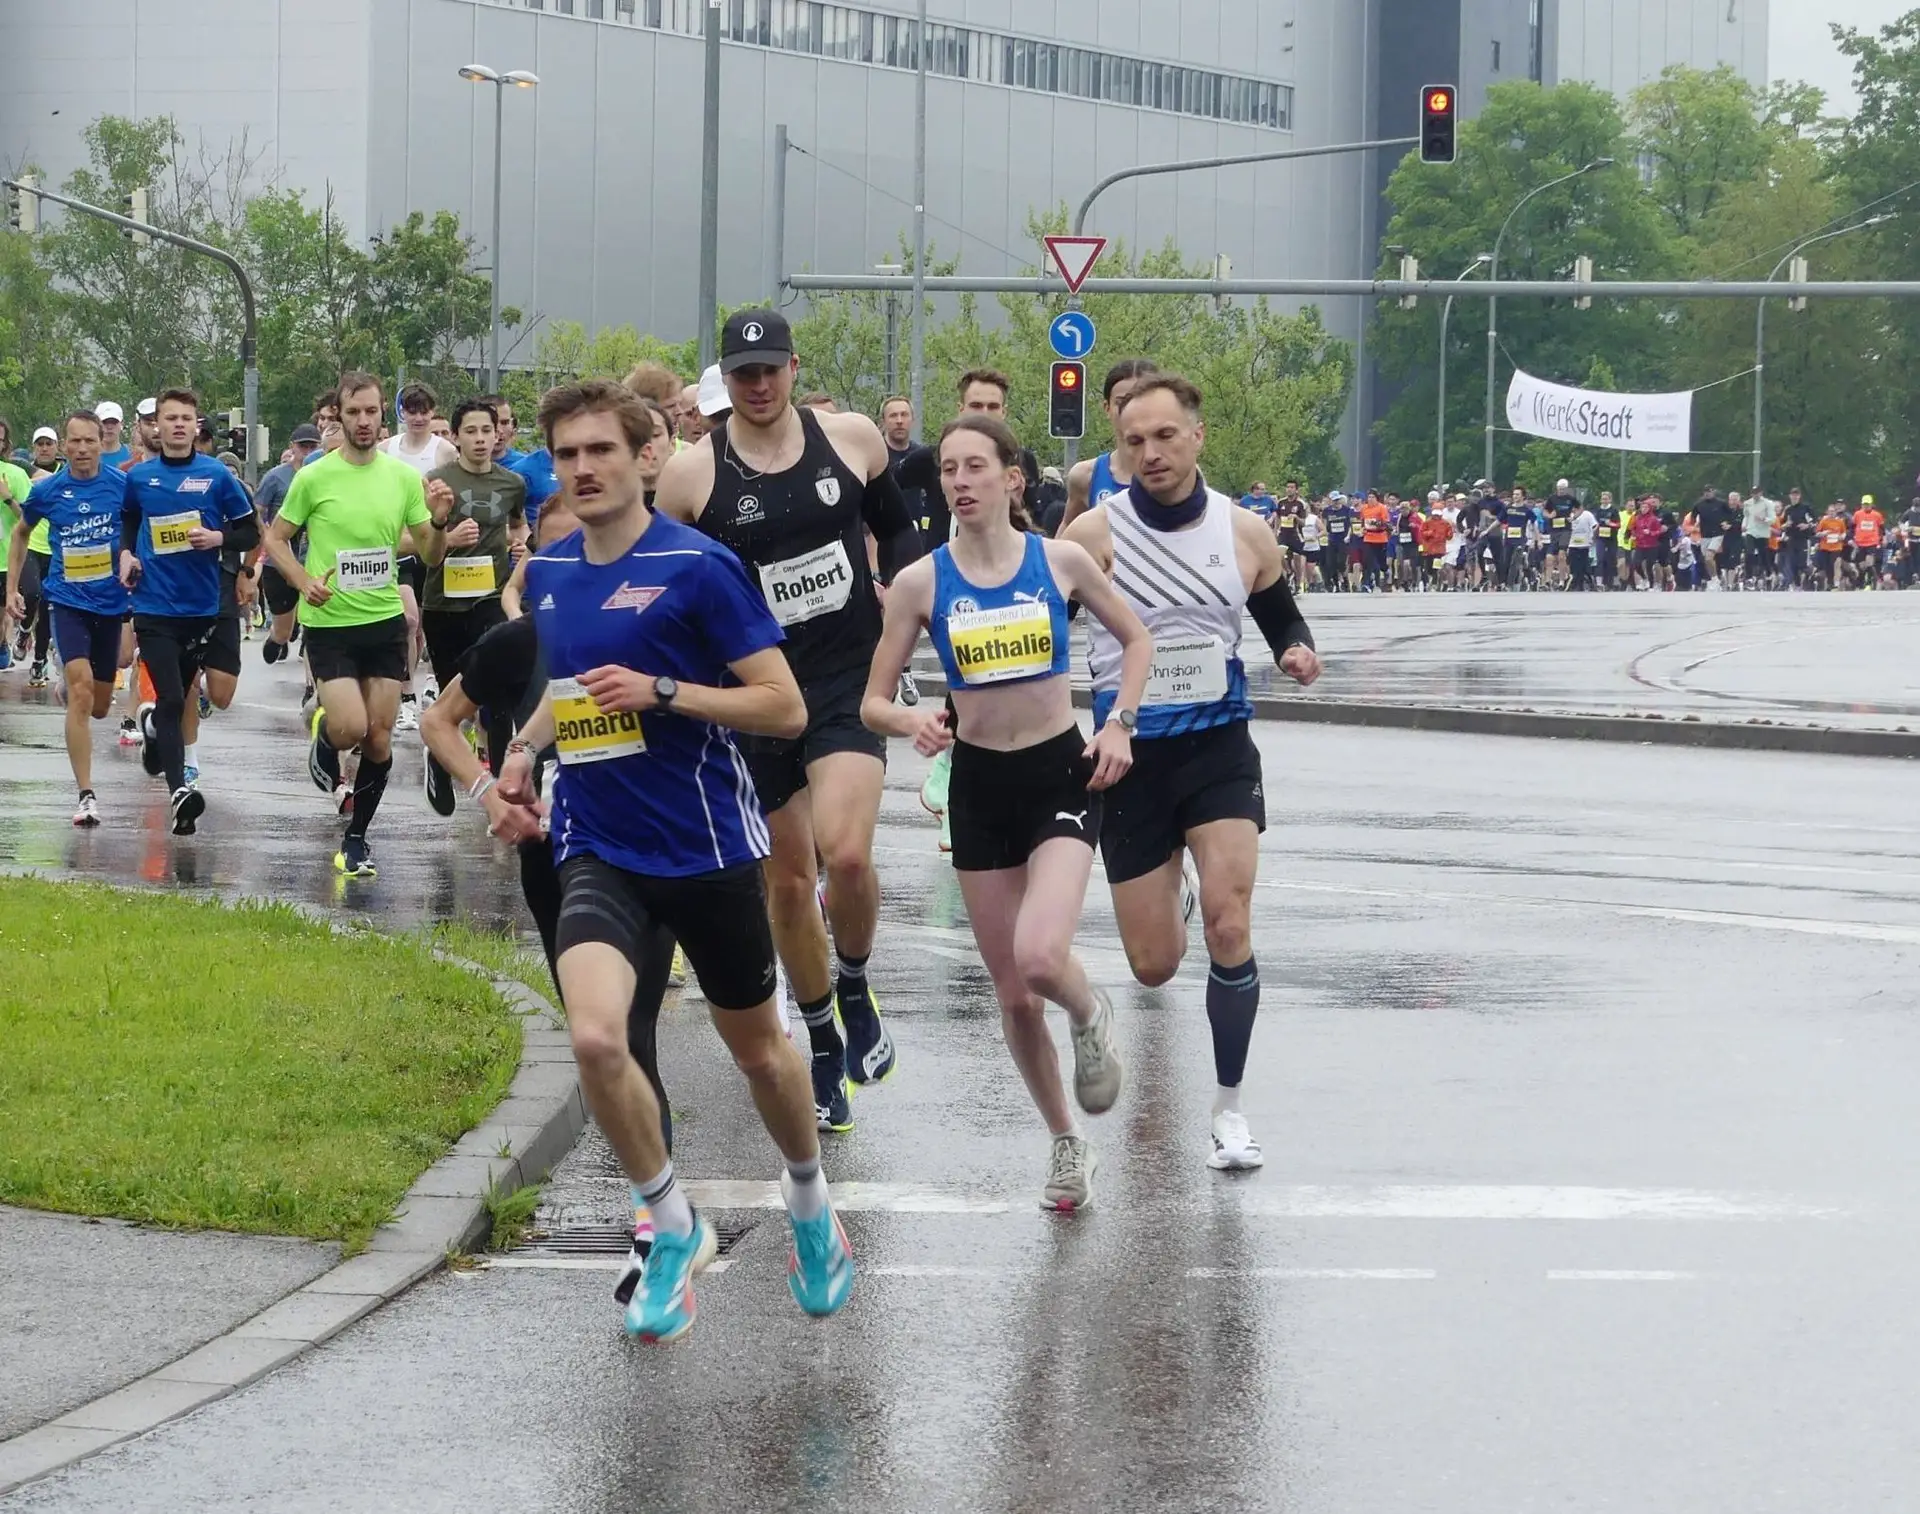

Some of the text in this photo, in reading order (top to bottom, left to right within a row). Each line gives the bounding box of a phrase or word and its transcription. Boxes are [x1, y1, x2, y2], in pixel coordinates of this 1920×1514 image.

[1533, 391, 1633, 439] WerkStadt
[160, 530, 190, 544] Elia
[341, 560, 389, 576] Philipp
[772, 562, 846, 603] Robert
[806, 595, 825, 607] 1202
[955, 633, 1051, 666] Nathalie
[1172, 683, 1192, 692] 1210
[556, 712, 637, 742] eonard
